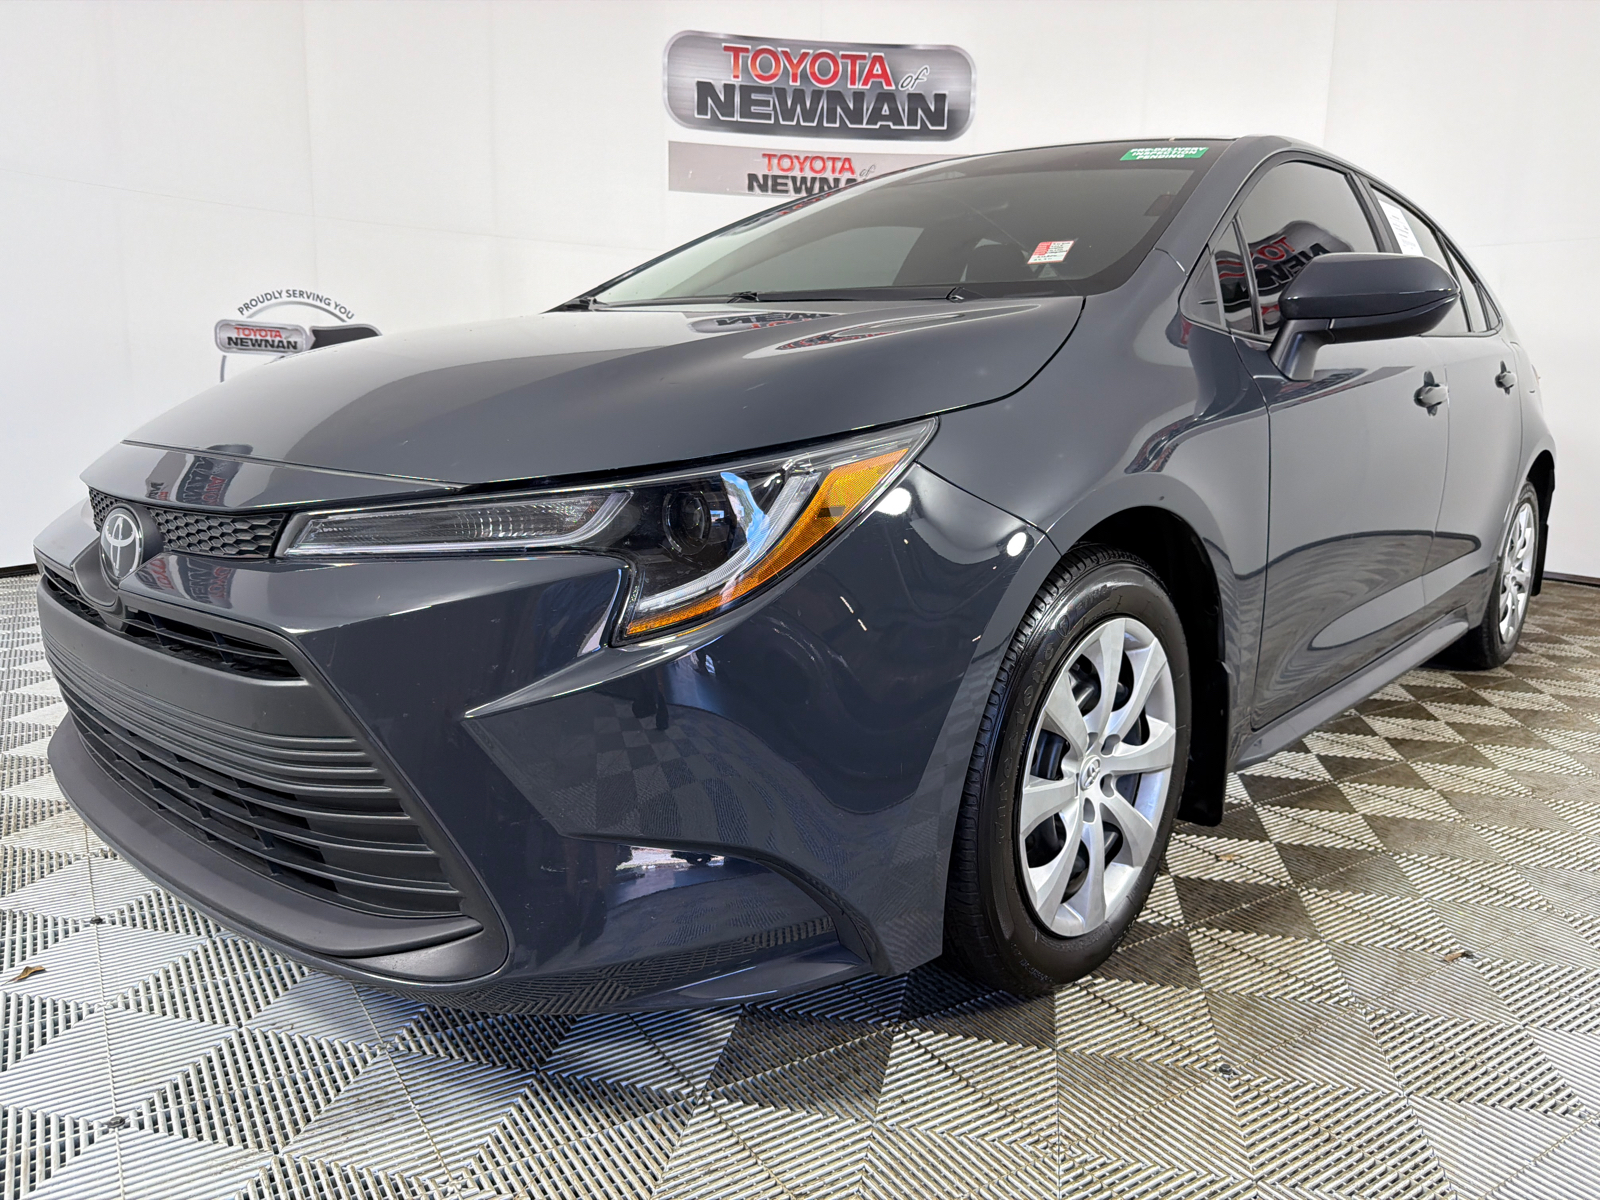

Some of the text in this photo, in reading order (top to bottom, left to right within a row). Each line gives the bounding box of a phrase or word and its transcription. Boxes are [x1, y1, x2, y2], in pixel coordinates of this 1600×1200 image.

[722, 44, 929, 91] TOYOTA of
[695, 80, 948, 130] NEWNAN
[762, 153, 856, 176] TOYOTA
[237, 289, 355, 320] PROUDLY SERVING YOU
[226, 336, 298, 350] NEWNAN
[234, 326, 283, 339] TOYOTA
